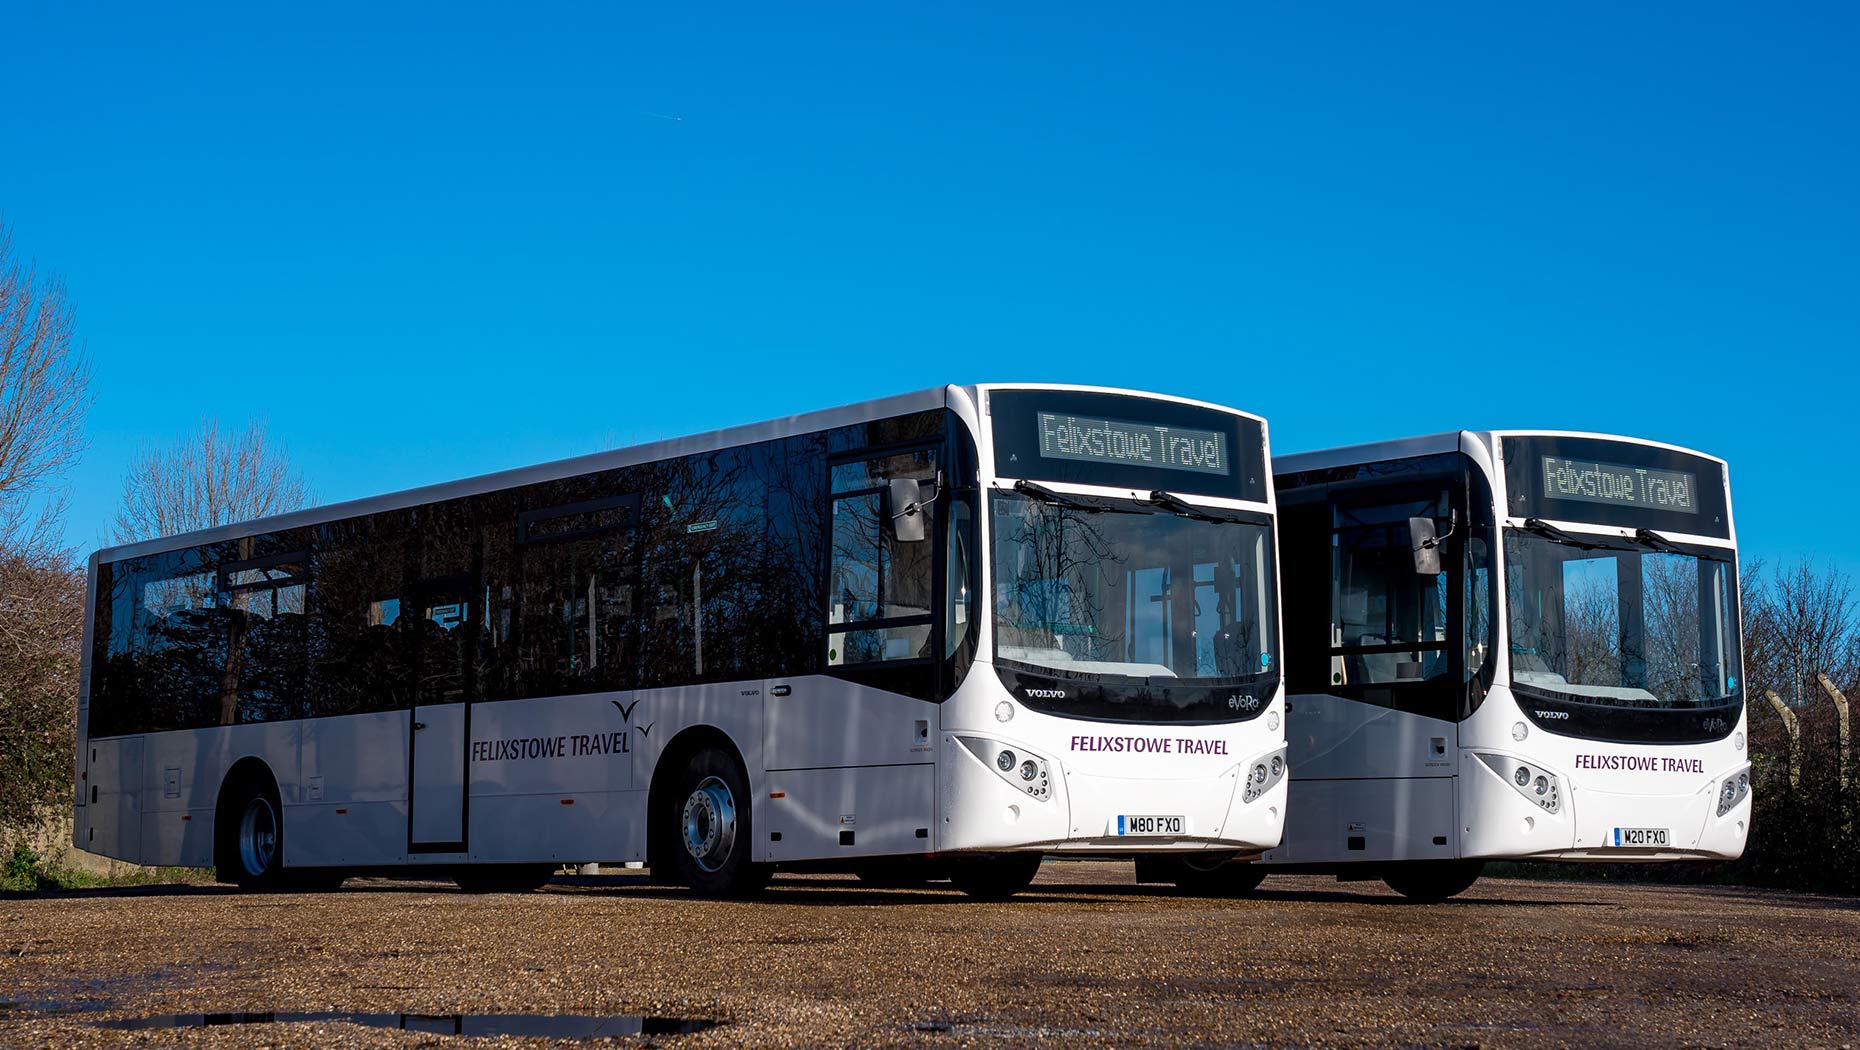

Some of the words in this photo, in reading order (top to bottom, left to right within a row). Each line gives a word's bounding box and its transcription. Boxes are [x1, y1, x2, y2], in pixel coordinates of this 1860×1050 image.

[1042, 413, 1152, 462] Felixstowe
[1154, 426, 1221, 469] Travel
[1544, 457, 1635, 501] Felixstowe
[1635, 468, 1691, 508] Travel
[1025, 688, 1066, 699] VOLVO
[1534, 710, 1569, 720] VOLVO
[472, 736, 566, 762] FELIXSTOWE
[570, 731, 630, 756] TRAVEL
[1070, 735, 1172, 754] FELIXSTOWE
[1175, 738, 1229, 755] TRAVEL
[1575, 754, 1658, 772] FELIXSTOWE
[1661, 757, 1704, 774] TRAVEL
[1130, 817, 1154, 832] M80
[1157, 817, 1180, 832] FXO
[1624, 830, 1644, 844] M20
[1646, 830, 1666, 844] FXO
